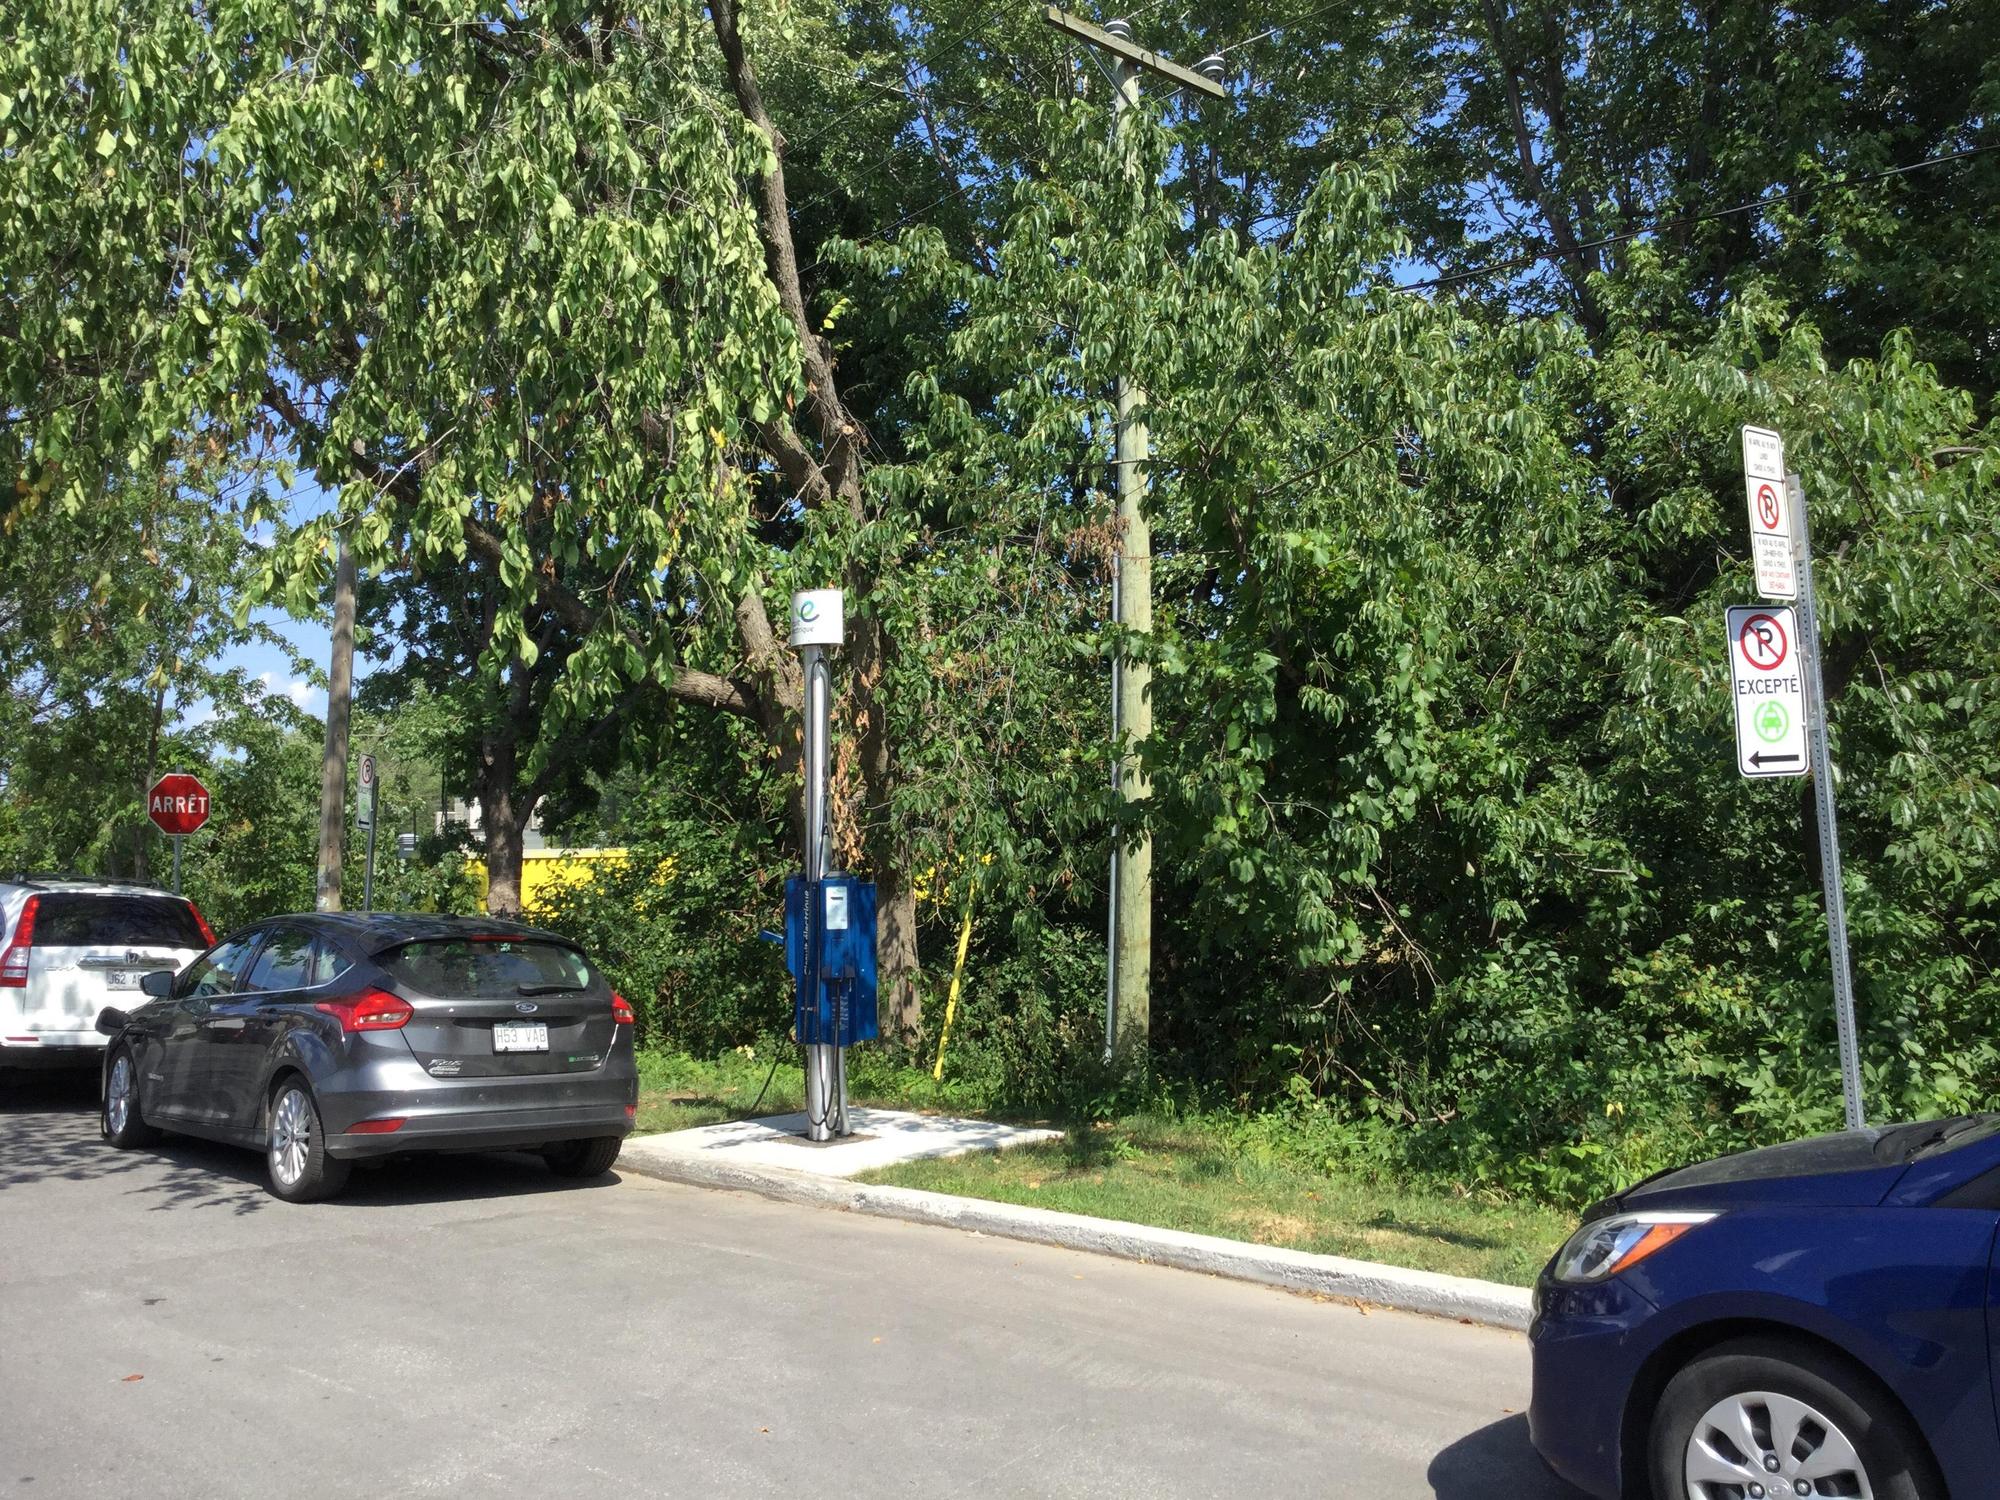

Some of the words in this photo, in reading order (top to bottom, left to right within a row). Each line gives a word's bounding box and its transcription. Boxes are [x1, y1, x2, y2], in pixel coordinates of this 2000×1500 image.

[1737, 674, 1800, 696] EXCEPTÉ
[151, 793, 208, 815] ARRÊT
[108, 973, 127, 985] J62
[495, 1028, 518, 1044] H53
[524, 1028, 547, 1044] VAB
